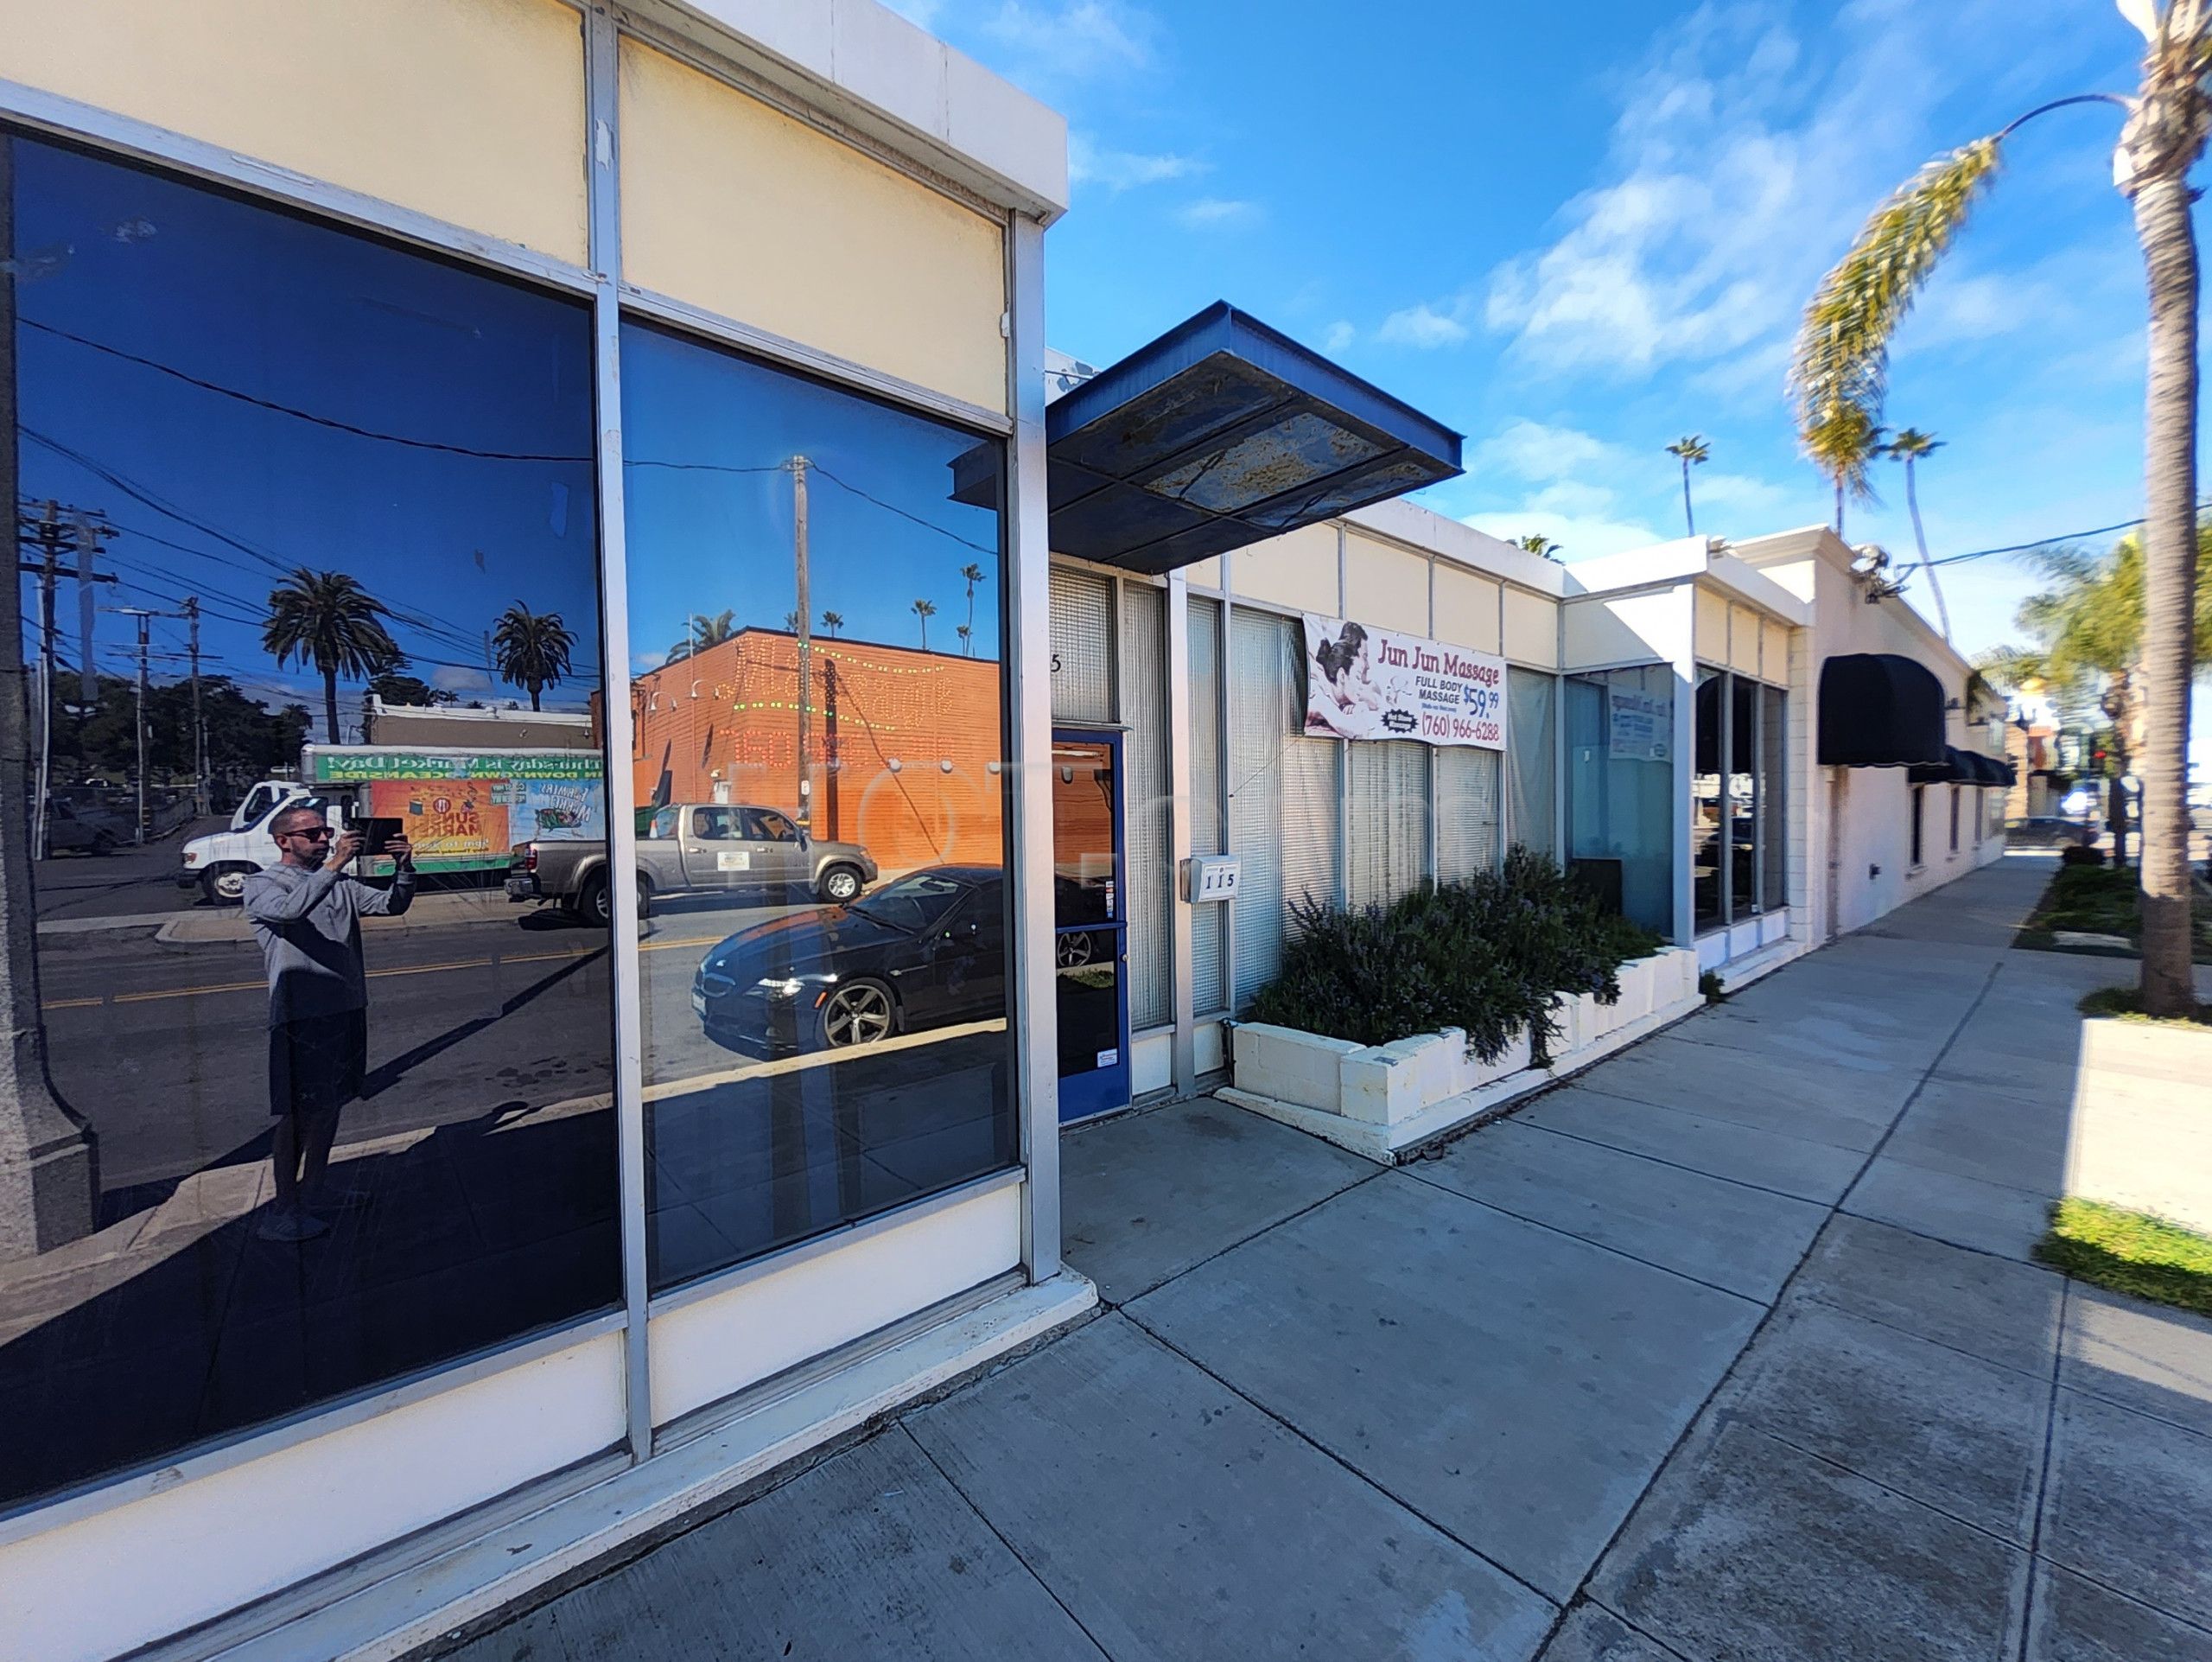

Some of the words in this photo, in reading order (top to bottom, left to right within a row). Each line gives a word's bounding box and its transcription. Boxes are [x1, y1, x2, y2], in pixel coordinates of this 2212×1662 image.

[1377, 639, 1408, 668] Jun
[1412, 646, 1440, 674] Jun
[1443, 653, 1500, 688] Massage
[1415, 676, 1438, 688] FULL
[1440, 678, 1464, 691] BODY
[1418, 689, 1460, 704] MASSAGE
[1422, 711, 1450, 738] (760)
[1452, 718, 1500, 742] 966-6288
[1205, 873, 1235, 889] 115
